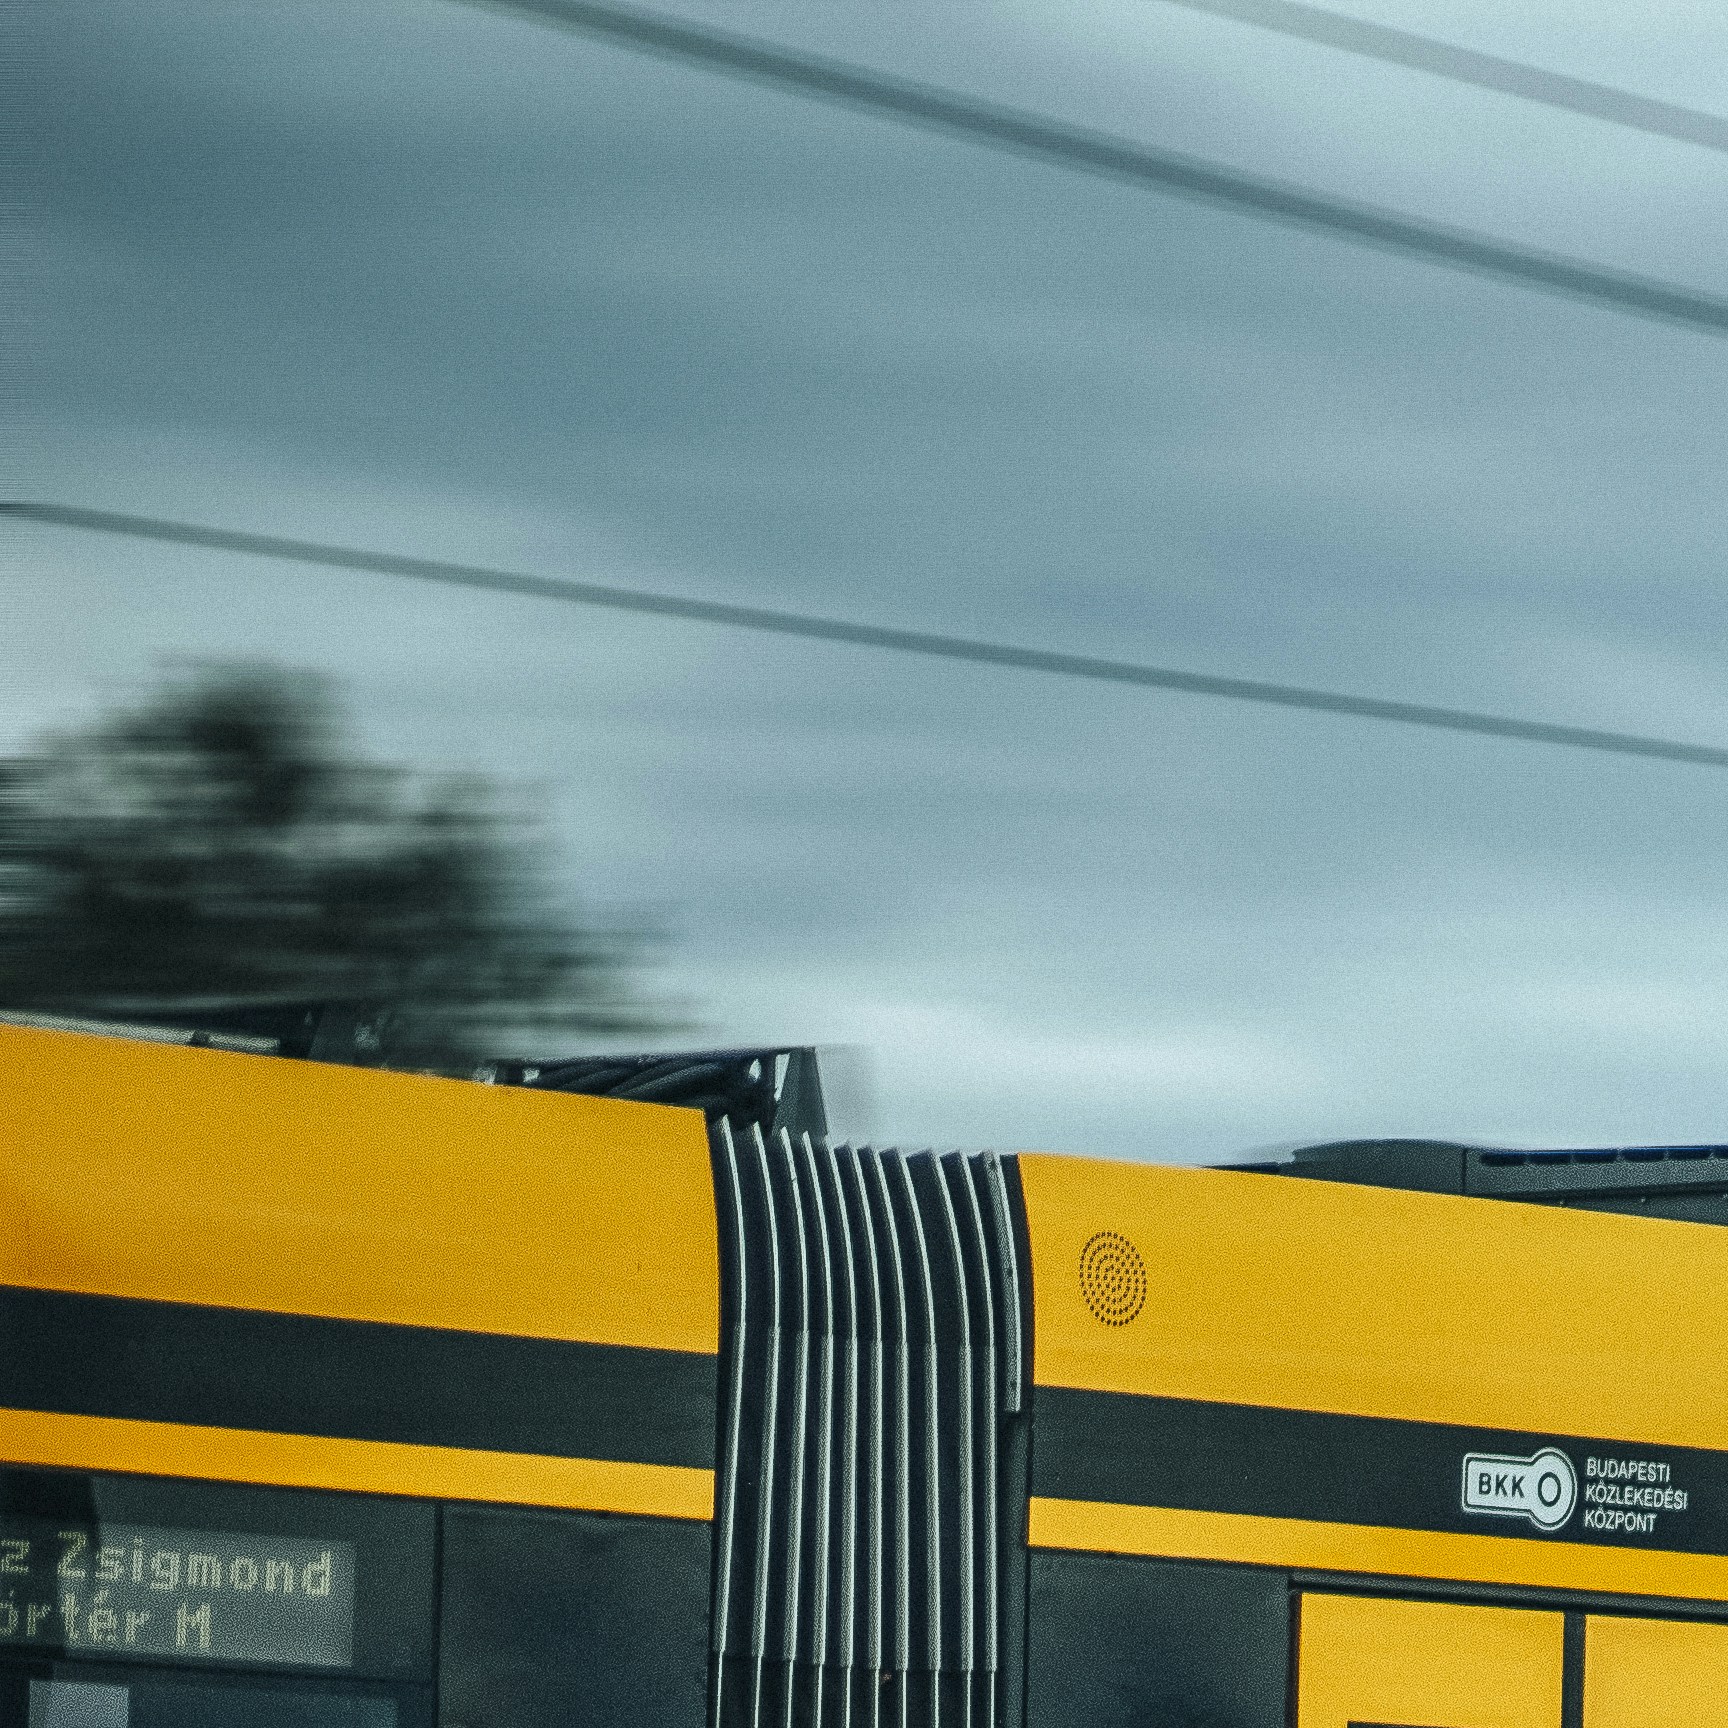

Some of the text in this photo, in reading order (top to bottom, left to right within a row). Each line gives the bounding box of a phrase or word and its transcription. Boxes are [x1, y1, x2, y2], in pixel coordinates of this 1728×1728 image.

[1585, 1456, 1671, 1483] BUDAPESTI
[1477, 1472, 1526, 1499] BKK
[1585, 1480, 1689, 1511] KÖZLEKEDÉSI
[1584, 1506, 1658, 1533] KÖZPONT
[57, 1530, 332, 1596] Zsigmond
[175, 1601, 213, 1650] M
